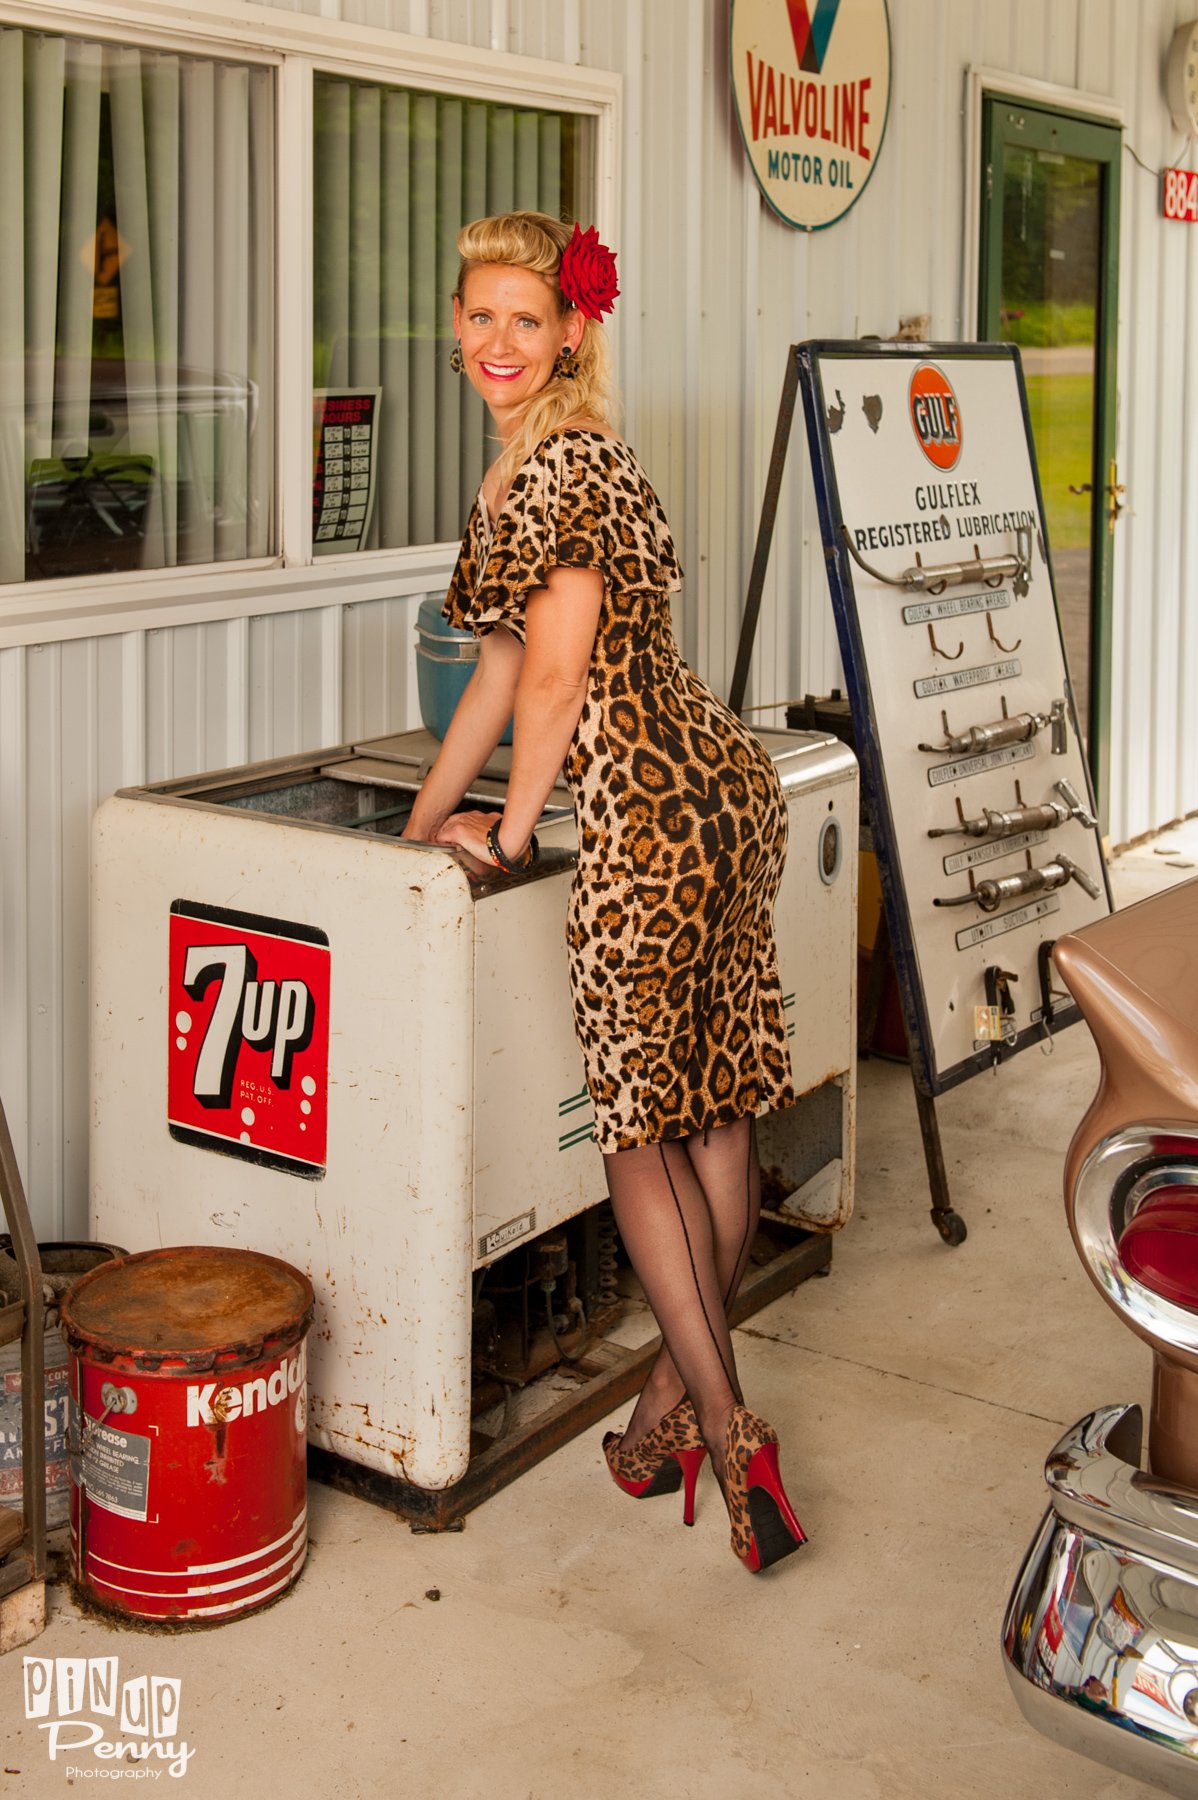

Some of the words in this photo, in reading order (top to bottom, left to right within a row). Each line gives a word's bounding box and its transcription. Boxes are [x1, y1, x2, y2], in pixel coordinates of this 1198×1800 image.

[747, 50, 871, 161] VALVOLINE
[768, 149, 823, 185] MOTOR
[829, 158, 853, 188] OIL
[320, 412, 361, 424] HOURS
[913, 394, 961, 443] GULF
[915, 481, 981, 511] GULFLEX
[855, 518, 951, 550] REGISTERED
[956, 510, 1036, 538] LUBRICATION
[908, 606, 933, 621] GULFLEX
[937, 601, 958, 616] WHEEL
[959, 597, 985, 612] BEARING
[922, 678, 948, 694] GULFLEX
[952, 667, 991, 687] WATERPROOF
[994, 663, 1017, 678] GREASE
[958, 757, 989, 776] UNIVERSAL
[990, 751, 1006, 767] JOINT
[971, 924, 993, 942] UTILITY
[1003, 911, 1028, 929] SUCTION
[240, 1079, 258, 1091] REG.
[240, 1090, 256, 1102] PAT.
[257, 1096, 274, 1108] OFF.
[96, 1442, 111, 1456] WHEEL
[112, 1450, 139, 1465] BEARING
[99, 1460, 119, 1474] GREASE
